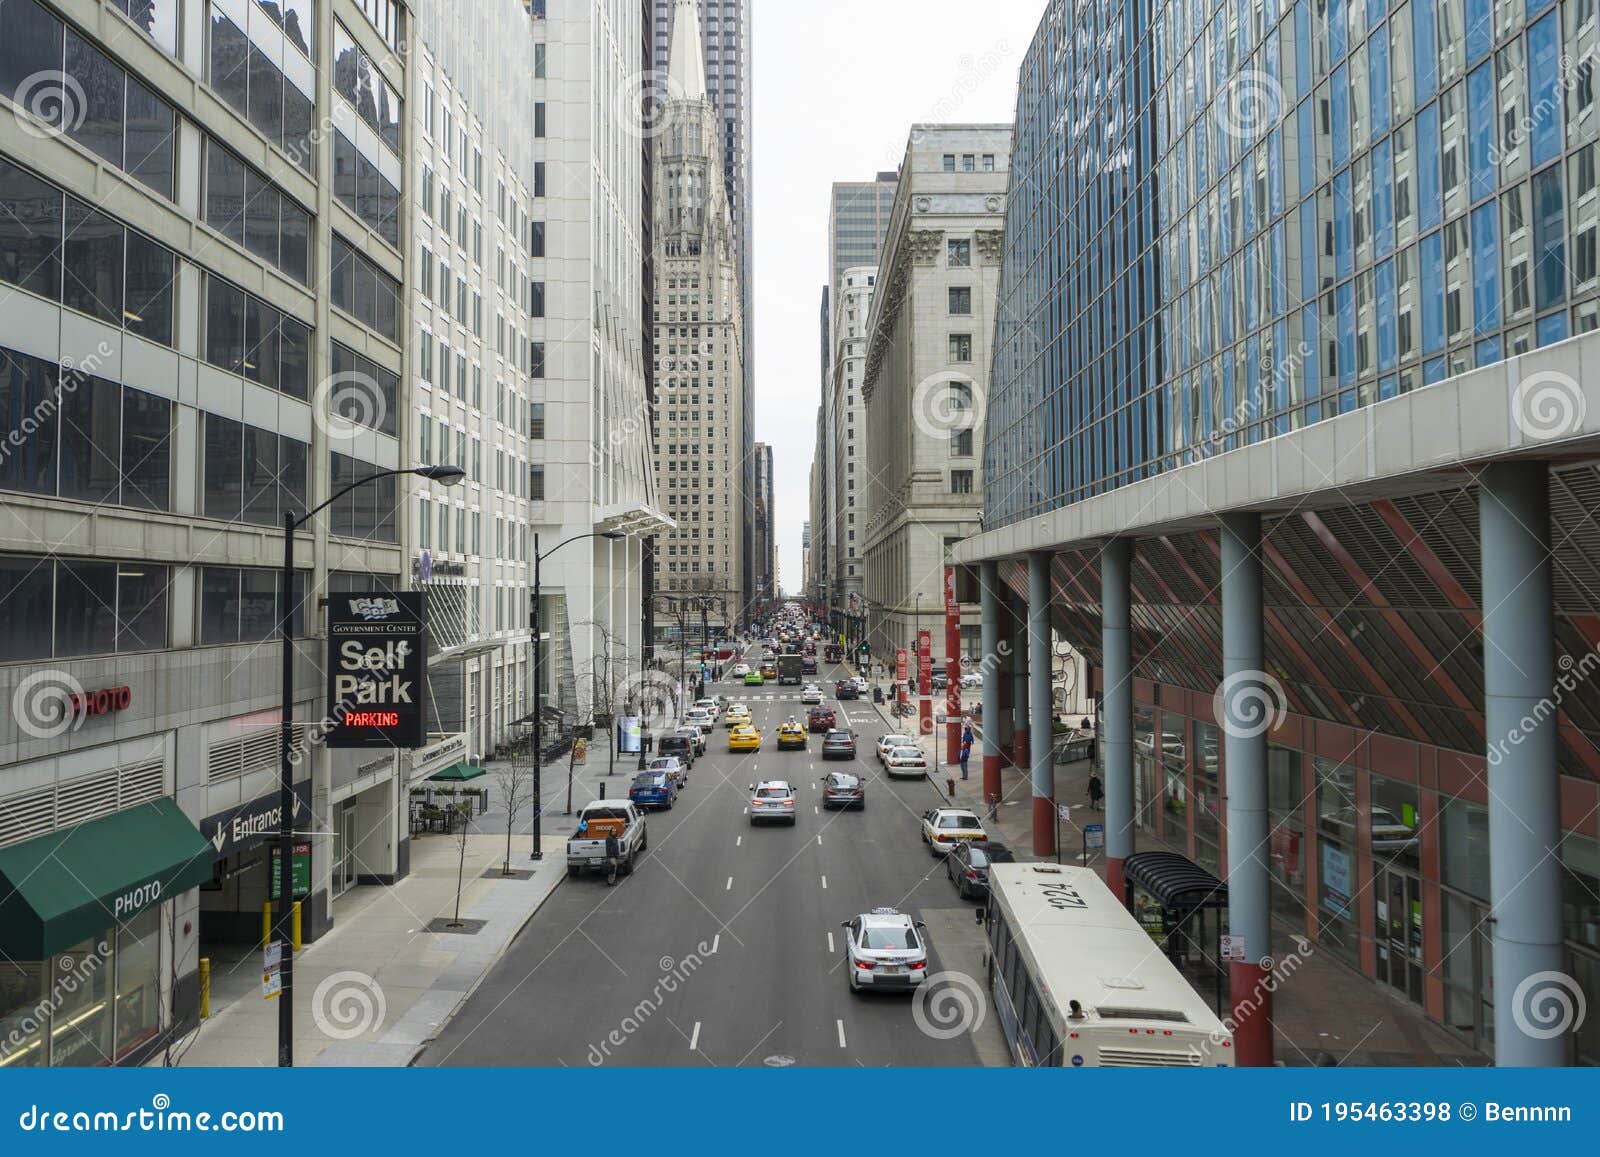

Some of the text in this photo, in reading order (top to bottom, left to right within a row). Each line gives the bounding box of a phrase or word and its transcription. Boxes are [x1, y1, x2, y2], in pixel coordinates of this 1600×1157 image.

[341, 640, 406, 670] Self
[70, 686, 131, 717] PHOTO
[335, 674, 412, 704] Park
[345, 712, 399, 727] PARKING
[115, 880, 161, 918] PHOTO
[1037, 883, 1089, 910] 1224
